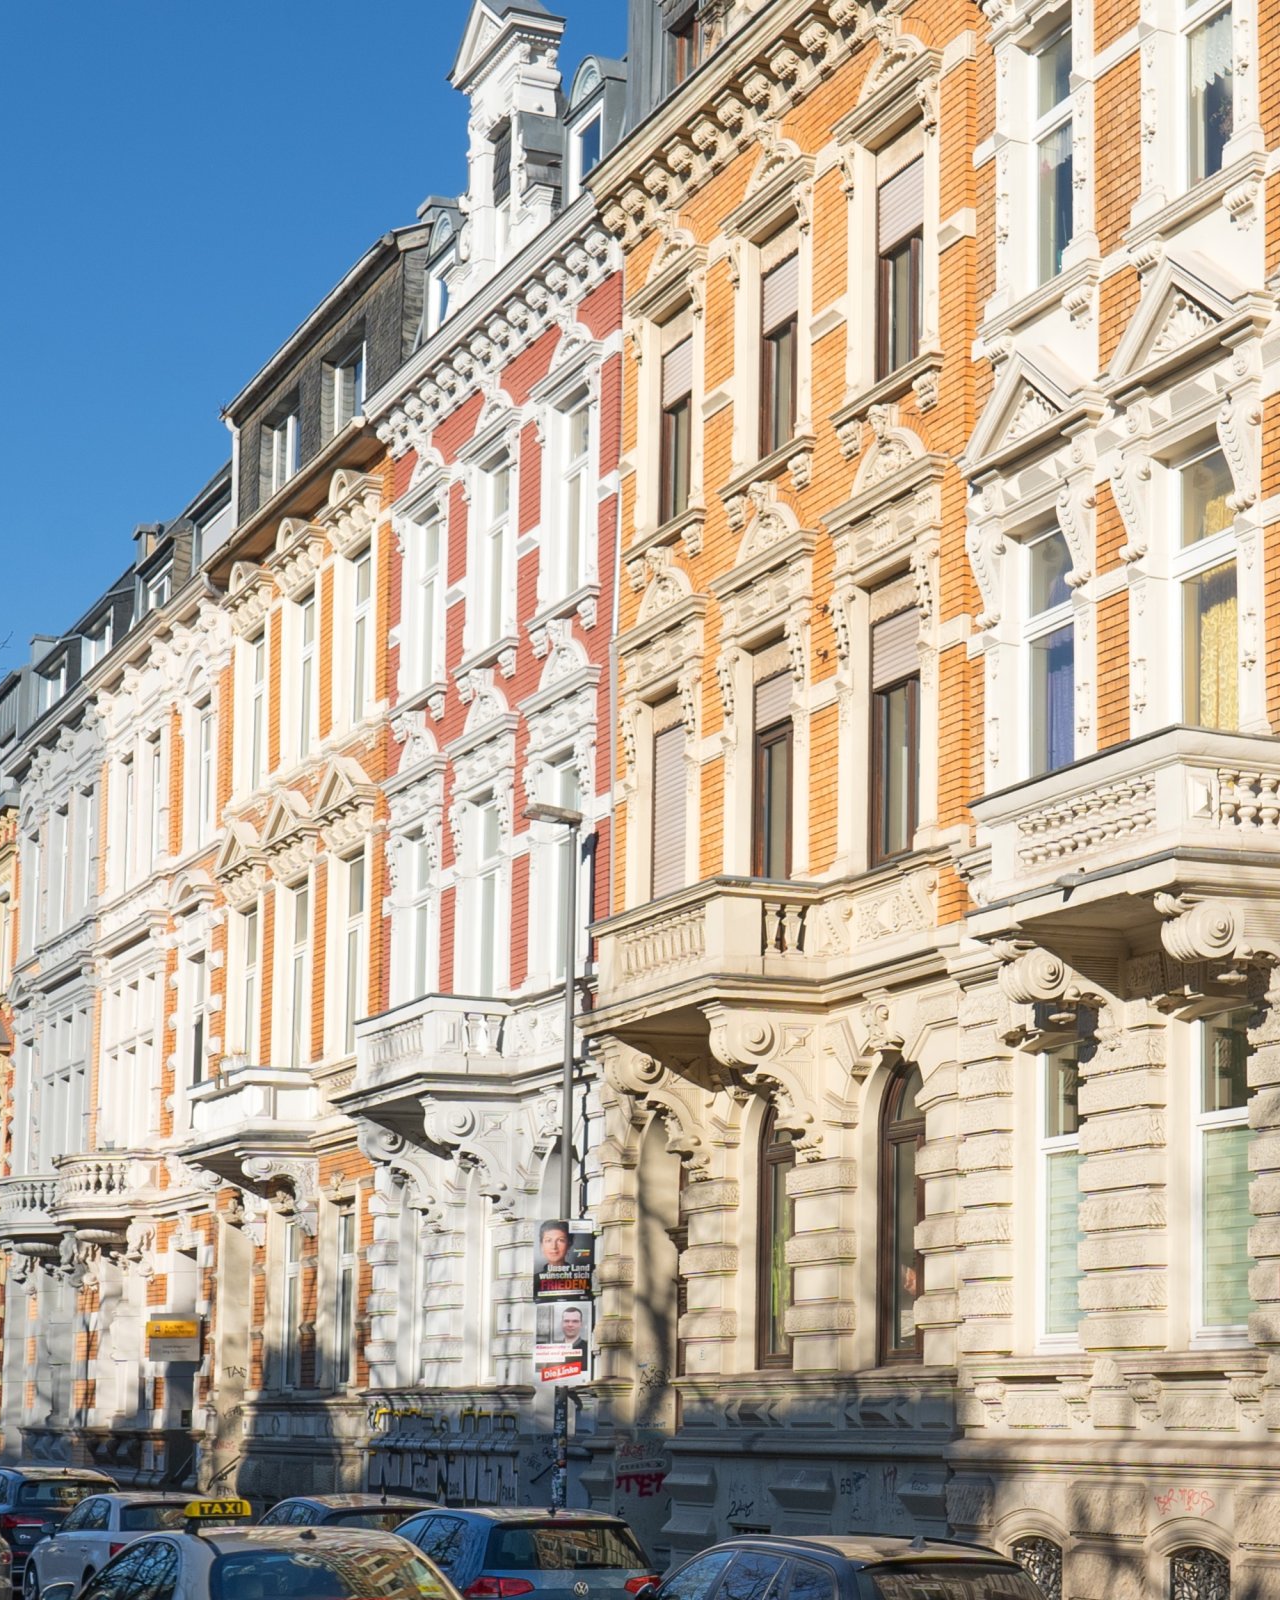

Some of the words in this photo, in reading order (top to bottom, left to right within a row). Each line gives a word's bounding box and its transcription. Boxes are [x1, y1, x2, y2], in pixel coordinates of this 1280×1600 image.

[547, 1264, 570, 1272] Unser
[571, 1264, 590, 1272] Land
[541, 1280, 590, 1290] FRIEDEN.
[201, 1503, 241, 1514] TAXI
